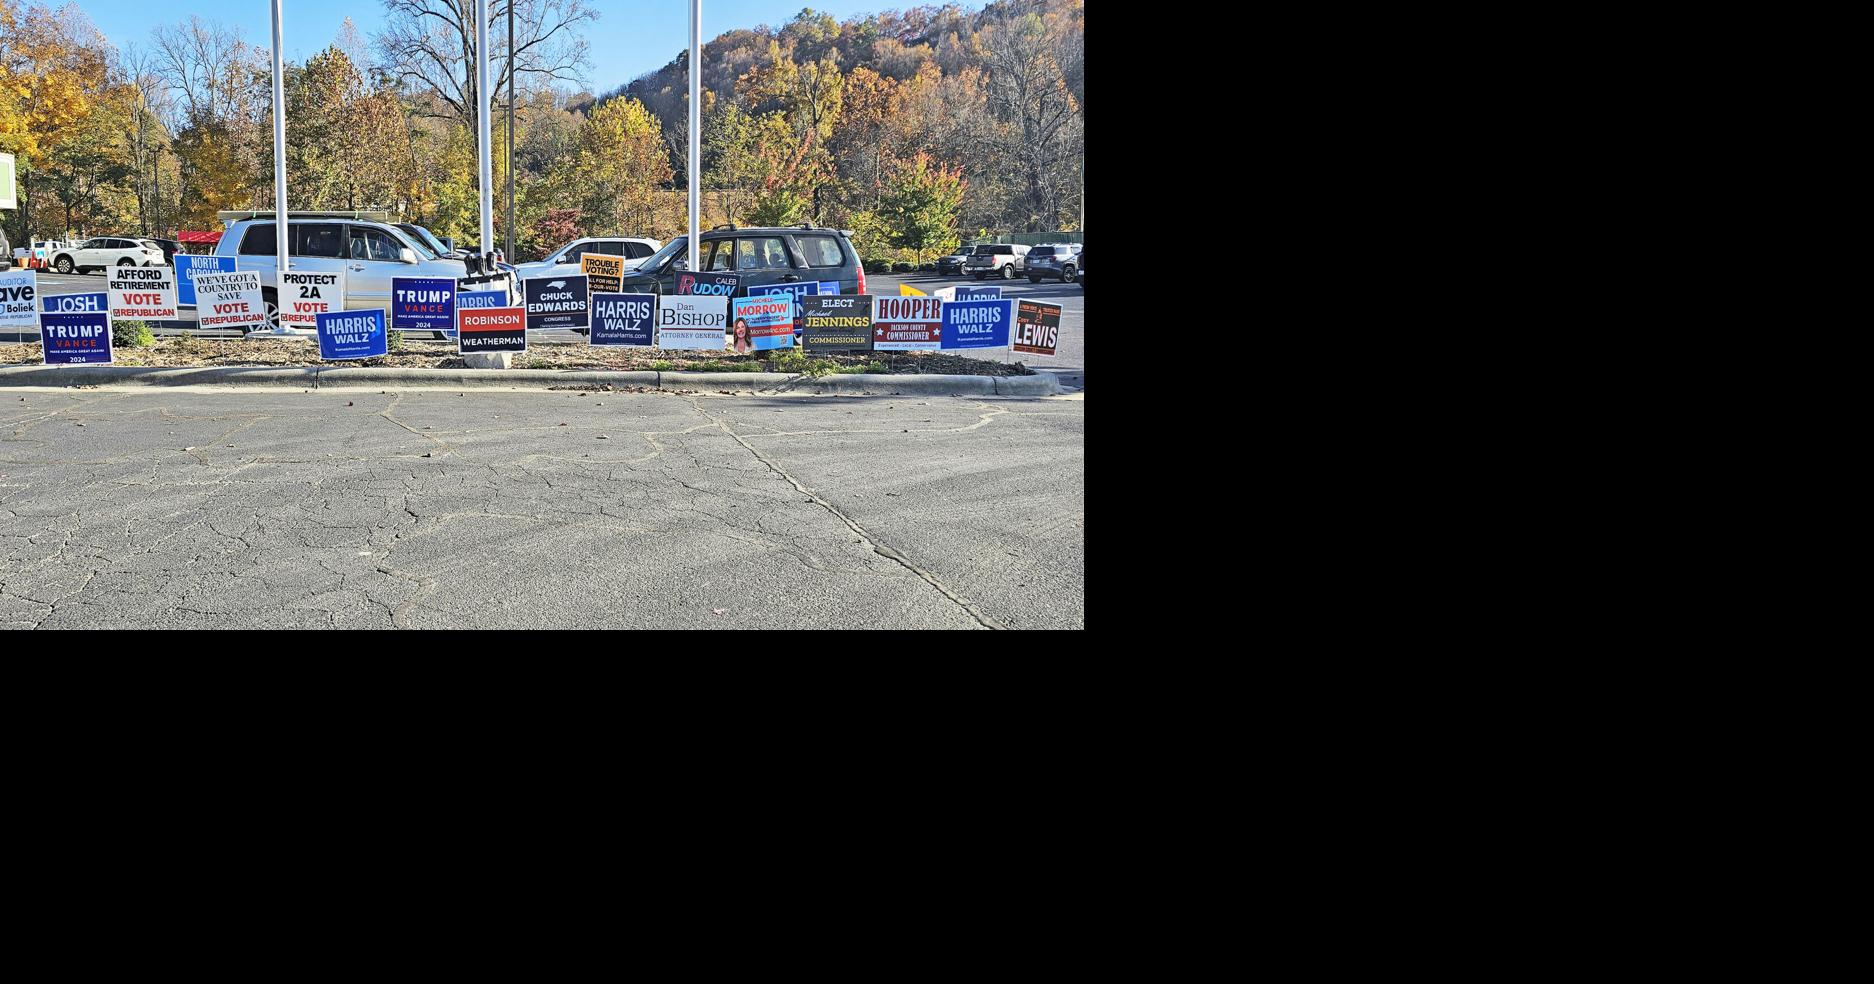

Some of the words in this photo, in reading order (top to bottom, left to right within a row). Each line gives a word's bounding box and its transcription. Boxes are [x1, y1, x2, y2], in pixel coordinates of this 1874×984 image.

[191, 257, 219, 269] NORTH
[585, 259, 620, 268] TROUBLE
[117, 269, 162, 280] AFFORD
[586, 267, 619, 276] VOTING?
[197, 275, 227, 285] WE'VE
[229, 273, 248, 283] GOT
[249, 273, 257, 282] A
[283, 274, 337, 285] PROTECT
[715, 277, 737, 285] CALEB
[110, 281, 170, 290] RETIREMENT
[198, 283, 243, 294] COUNTRY
[244, 281, 258, 291] TO
[678, 274, 735, 296] RUDOW
[218, 292, 242, 300] SAVE
[300, 286, 321, 299] 2A
[397, 290, 451, 303] TRUMP
[540, 292, 573, 301] CHUCK
[55, 296, 98, 312] JOSH
[123, 293, 162, 305] VOTE
[821, 299, 854, 308] ELECT
[7, 302, 34, 313] Boliek
[213, 303, 249, 314] VOTE
[293, 302, 328, 313] VOTE
[404, 304, 443, 313] VANCE
[528, 301, 586, 313] EDWARDS
[596, 301, 650, 319] HARRIS
[737, 304, 787, 316] MORROW
[878, 299, 940, 319] HOOPER
[121, 309, 174, 317] REPUBLICAN
[661, 308, 725, 326] BISHOP
[950, 307, 1001, 324] HARRIS
[209, 314, 264, 324] REPUBLICAN
[465, 315, 520, 325] ROBINSON
[805, 316, 870, 327] JENNINGS
[326, 316, 376, 335] HARRIS
[603, 319, 641, 331] WALZ
[957, 324, 993, 334] WALZ
[46, 325, 103, 338] TRUMP
[886, 331, 930, 340] COMMISSIONER
[1015, 323, 1057, 348] LEWIS
[56, 339, 97, 347] VANCE
[334, 333, 369, 344] WALZ
[462, 337, 524, 346] WEATHERMAN
